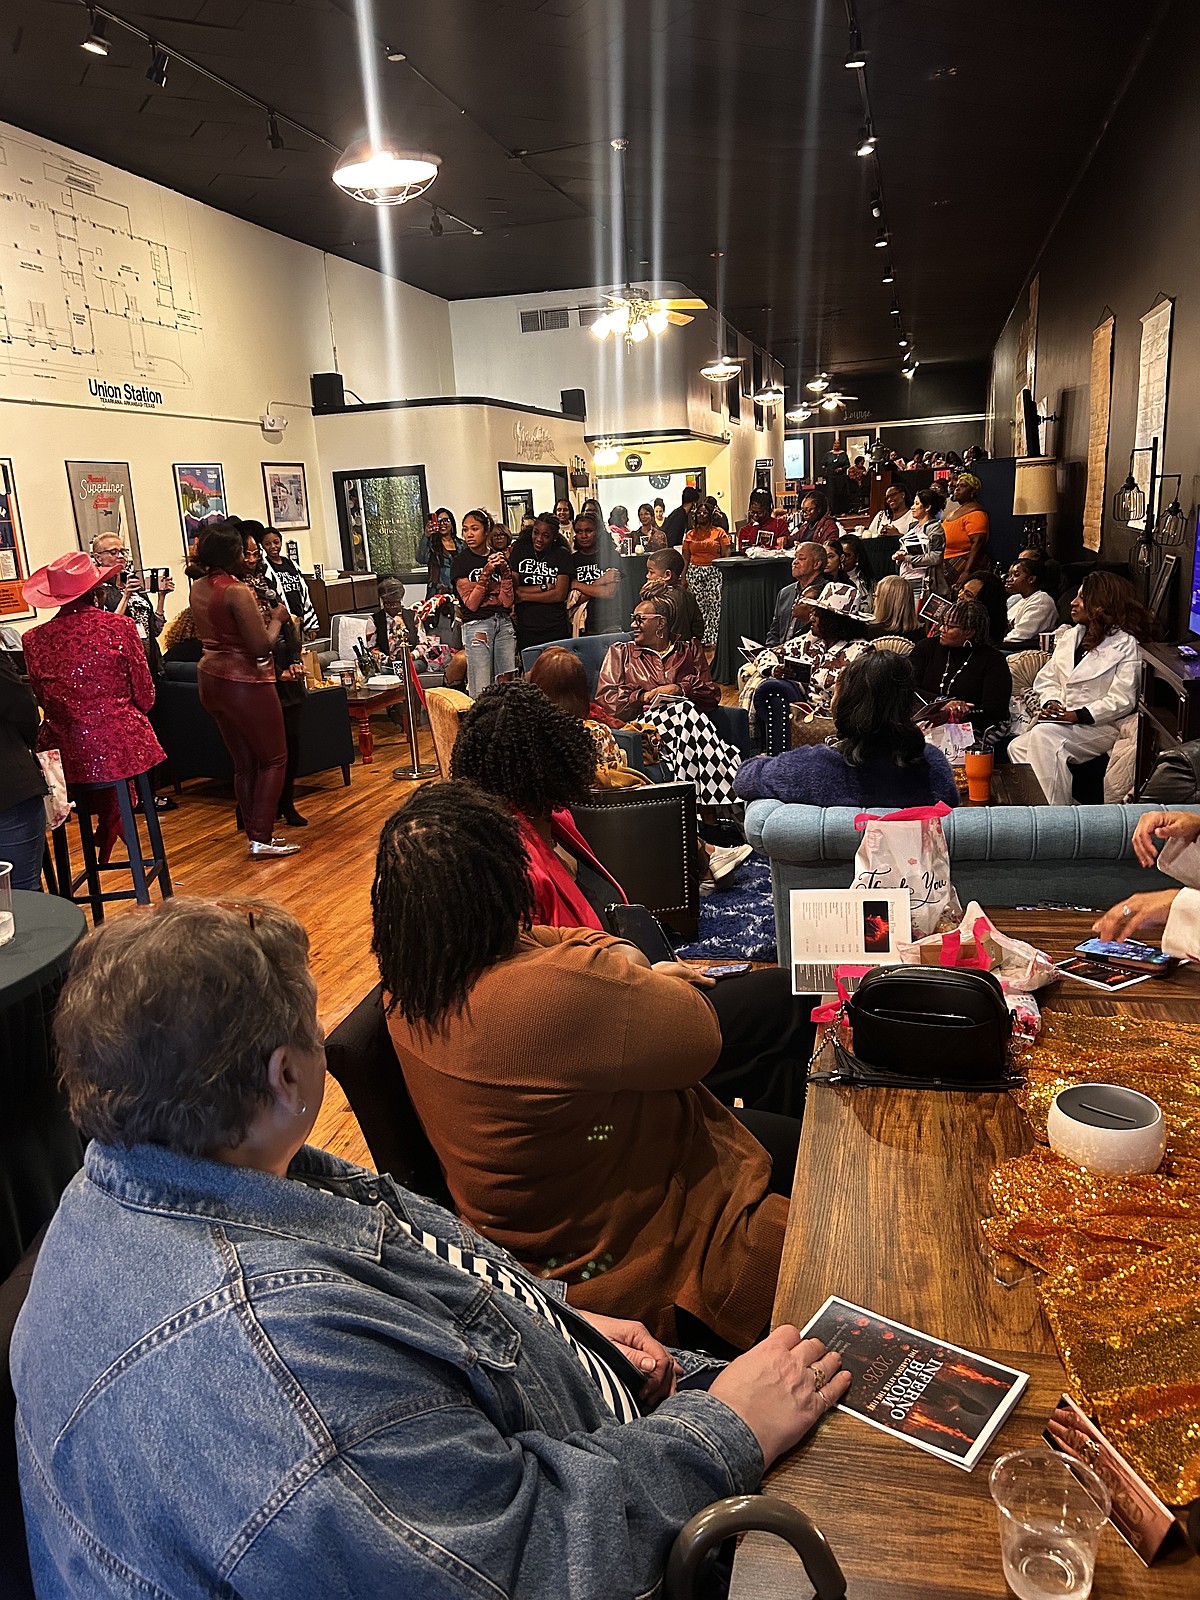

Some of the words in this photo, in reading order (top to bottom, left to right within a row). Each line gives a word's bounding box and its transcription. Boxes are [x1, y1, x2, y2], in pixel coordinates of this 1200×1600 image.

[88, 378, 122, 399] Union
[123, 383, 163, 405] Station
[844, 410, 872, 420] Lounge
[79, 479, 124, 500] Superliner
[857, 868, 910, 889] Thk
[914, 871, 947, 905] You
[907, 1348, 919, 1359] THE
[862, 1354, 894, 1384] 2026
[893, 1357, 911, 1377] GARDEN
[881, 1359, 925, 1408] BLOOM
[882, 1376, 897, 1391] AFTER
[890, 1358, 943, 1420] INFERNO
[866, 1399, 879, 1412] FIRE
[876, 1390, 887, 1401] THE
